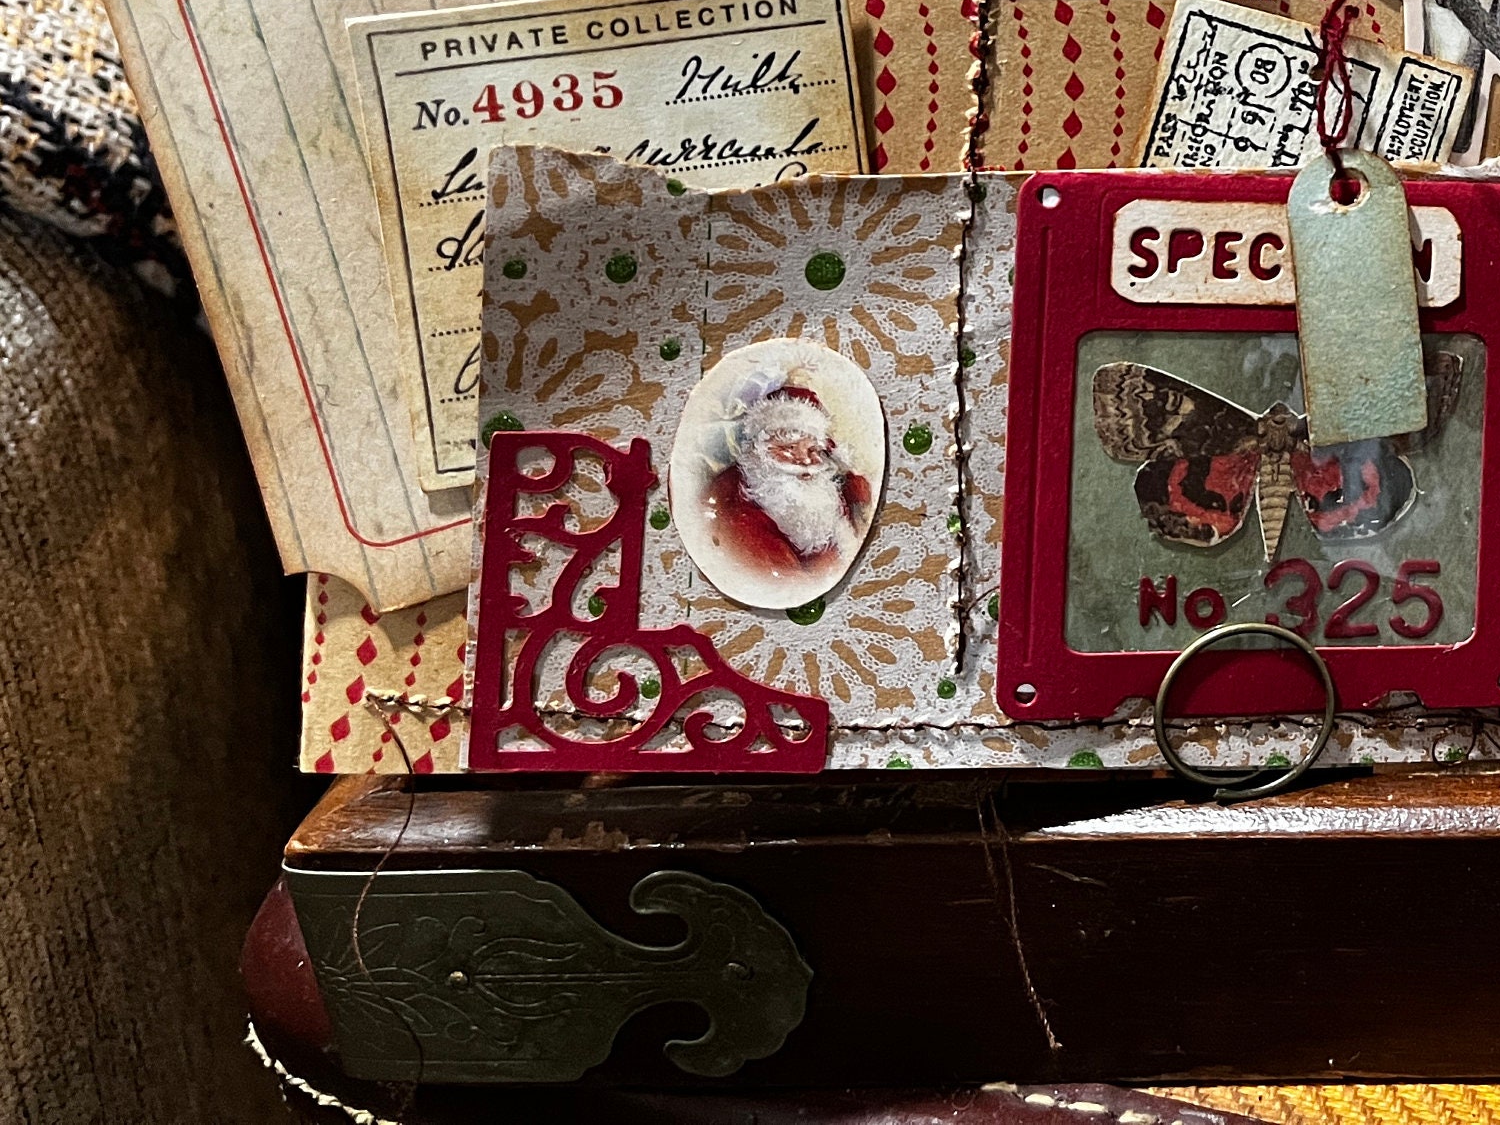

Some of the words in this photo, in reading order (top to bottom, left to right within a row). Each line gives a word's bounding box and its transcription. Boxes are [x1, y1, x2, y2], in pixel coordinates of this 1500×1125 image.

[421, 24, 570, 61] PRIVATE
[411, 98, 470, 132] No.
[471, 69, 625, 124] 4935
[1127, 225, 1436, 283] SPECN
[1263, 557, 1445, 640] 325
